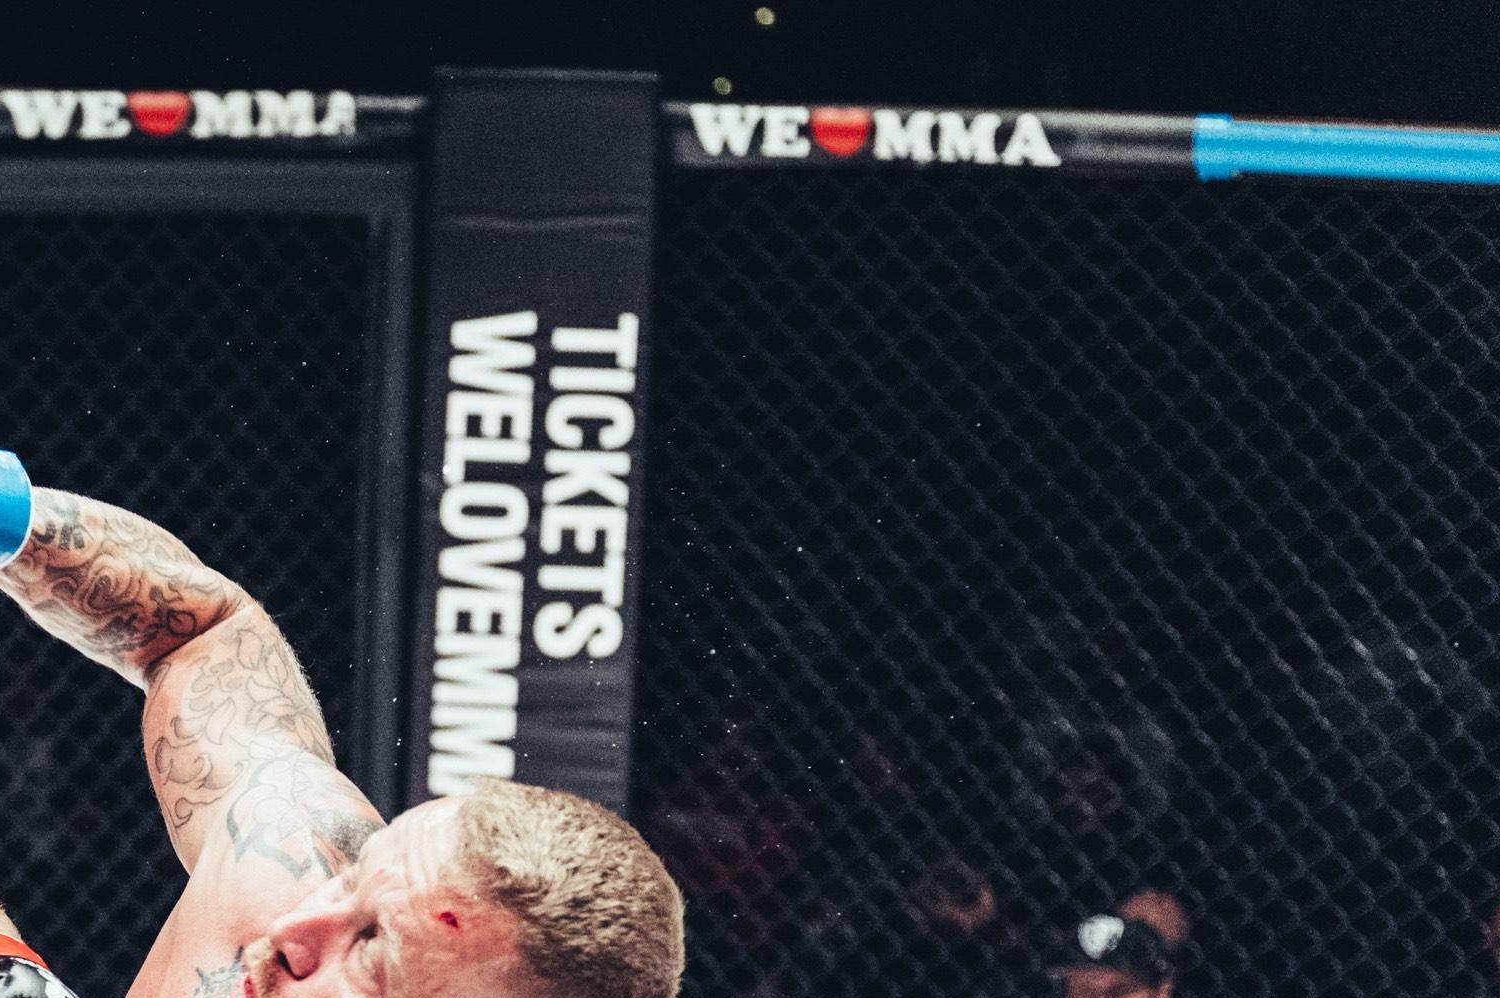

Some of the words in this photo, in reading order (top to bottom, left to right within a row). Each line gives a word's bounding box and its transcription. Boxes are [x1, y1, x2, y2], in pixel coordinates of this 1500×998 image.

[1, 90, 131, 139] WE
[690, 104, 811, 158] WE
[872, 109, 1062, 167] MMA
[533, 311, 640, 659] TICKETS
